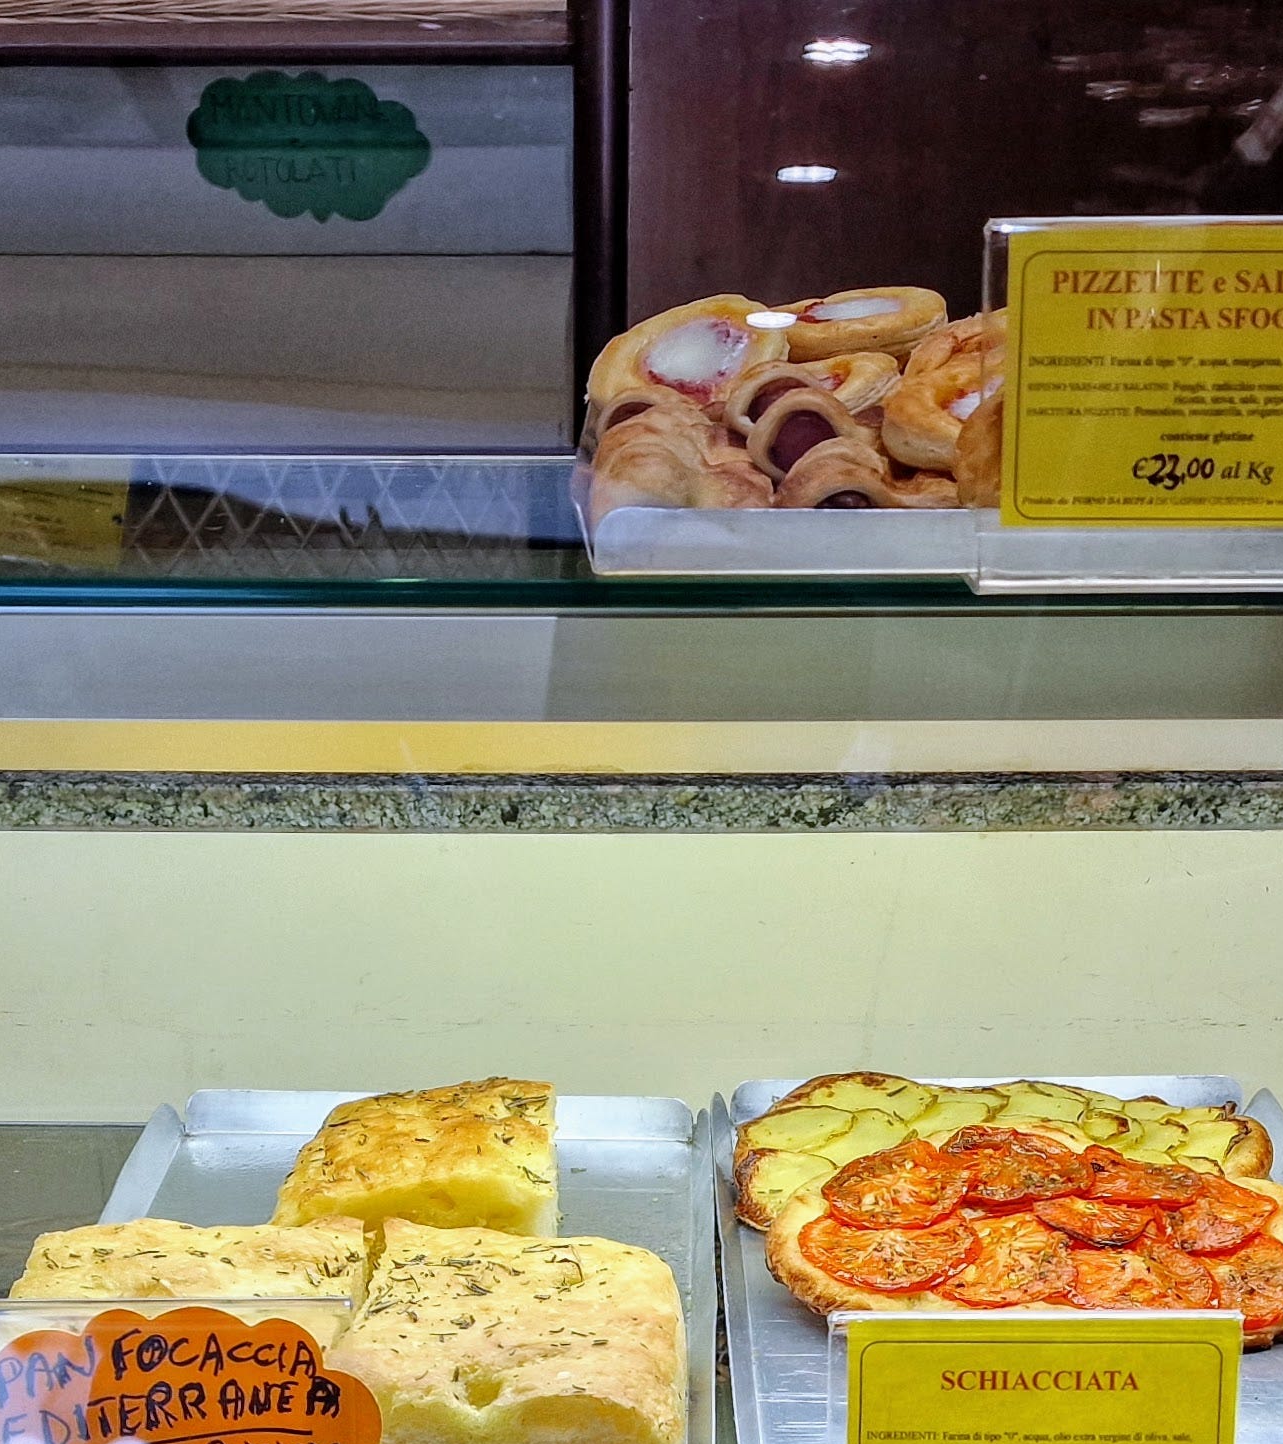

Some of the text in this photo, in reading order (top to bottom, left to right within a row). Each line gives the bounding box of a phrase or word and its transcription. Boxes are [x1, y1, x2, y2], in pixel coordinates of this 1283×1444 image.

[1052, 269, 1205, 294] PIZZETTE
[1213, 276, 1227, 294] e
[1087, 308, 1116, 330] IN
[1124, 308, 1210, 330] PASTA
[1221, 461, 1241, 479] al
[1248, 461, 1274, 486] Kg
[112, 1327, 316, 1380] FOCACCIA
[940, 1370, 1140, 1392] SCHIACCIATA
[942, 1431, 971, 1441] Farina
[972, 1431, 982, 1441] di
[983, 1432, 1002, 1443] tipo
[1053, 1432, 1071, 1442] olio
[1132, 1432, 1143, 1442] di
